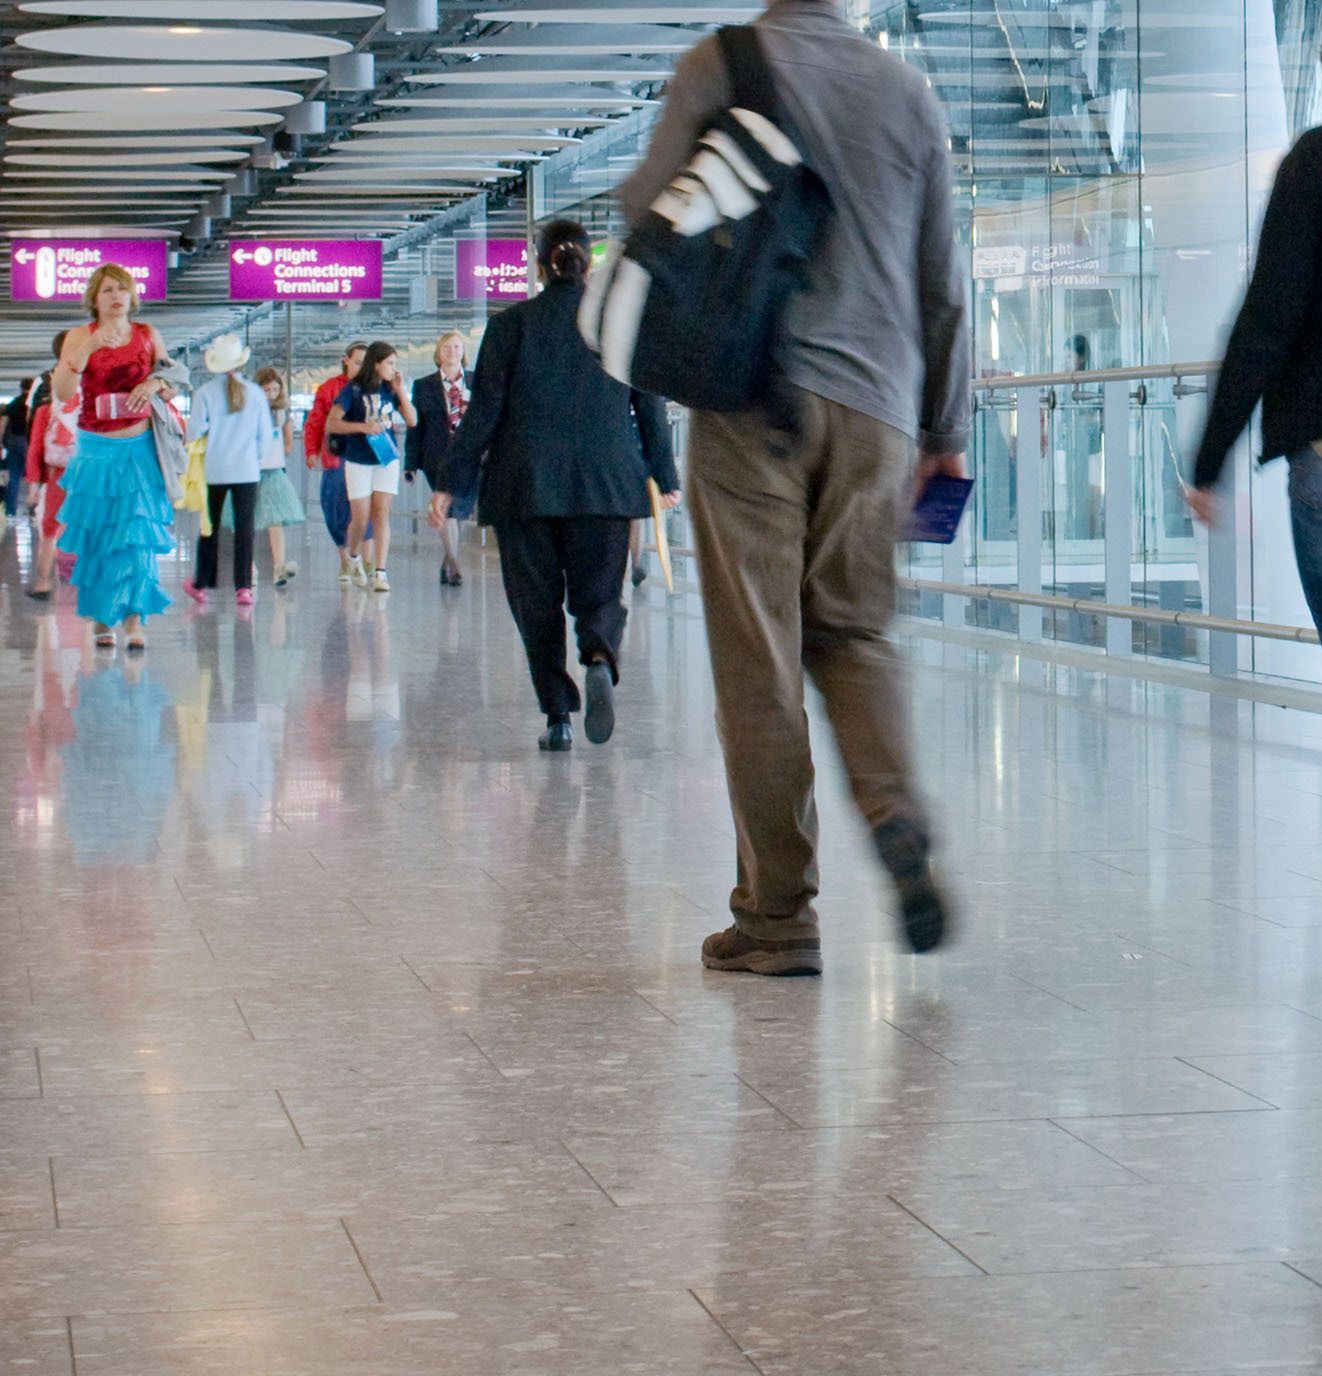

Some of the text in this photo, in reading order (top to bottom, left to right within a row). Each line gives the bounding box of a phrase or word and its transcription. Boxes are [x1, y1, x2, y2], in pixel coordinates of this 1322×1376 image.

[57, 248, 101, 265] Flight
[274, 248, 318, 264] Flight
[274, 263, 365, 277] Connections
[274, 279, 351, 293] Terminal 5
